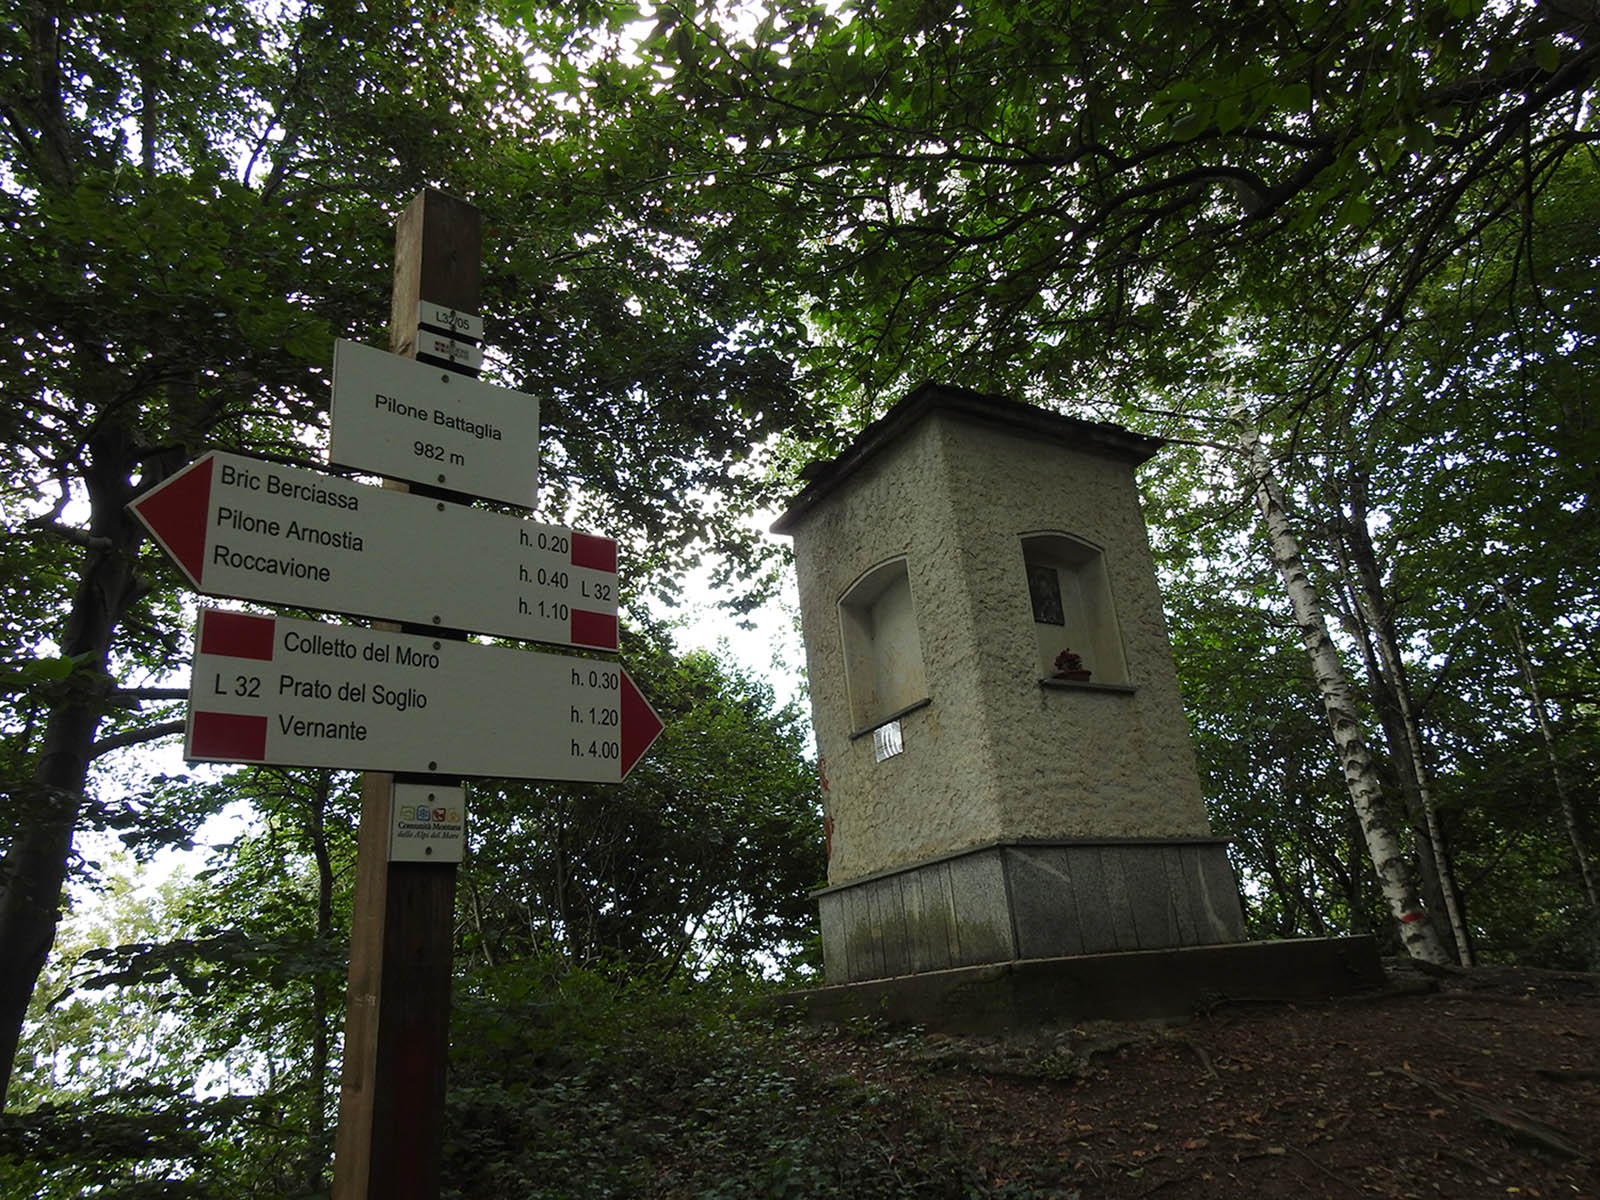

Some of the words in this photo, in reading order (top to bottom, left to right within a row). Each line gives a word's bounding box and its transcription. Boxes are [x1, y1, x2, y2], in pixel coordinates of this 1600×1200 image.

[375, 394, 428, 421] Pilone
[433, 410, 502, 440] Battaglia
[414, 441, 445, 461] 982
[450, 452, 465, 466] m
[221, 464, 260, 491] Bric
[267, 474, 359, 511] Berciassa
[217, 507, 280, 536] Pilone
[286, 521, 364, 552] Arnostia
[520, 529, 533, 547] h.
[538, 532, 569, 554] 0.20
[213, 544, 331, 582] Roccavione
[519, 564, 532, 583] h.
[537, 568, 569, 589] 0.40
[582, 580, 590, 598] L
[594, 583, 611, 601] 32
[519, 596, 532, 615] h.
[538, 600, 569, 621] 1.10
[284, 631, 357, 659] Colletto
[363, 642, 390, 663] del
[396, 646, 440, 669] Moro
[215, 673, 227, 695] L
[235, 675, 261, 698] 32
[571, 668, 584, 686] h.
[589, 671, 619, 690] 0.30
[279, 675, 332, 700] Prato
[338, 682, 366, 703] del
[372, 685, 428, 712] Soglio
[278, 714, 368, 741] Vernante
[571, 705, 584, 723] h.
[589, 707, 619, 726] 1.20
[571, 739, 584, 757] h.
[588, 741, 619, 759] 4.00
